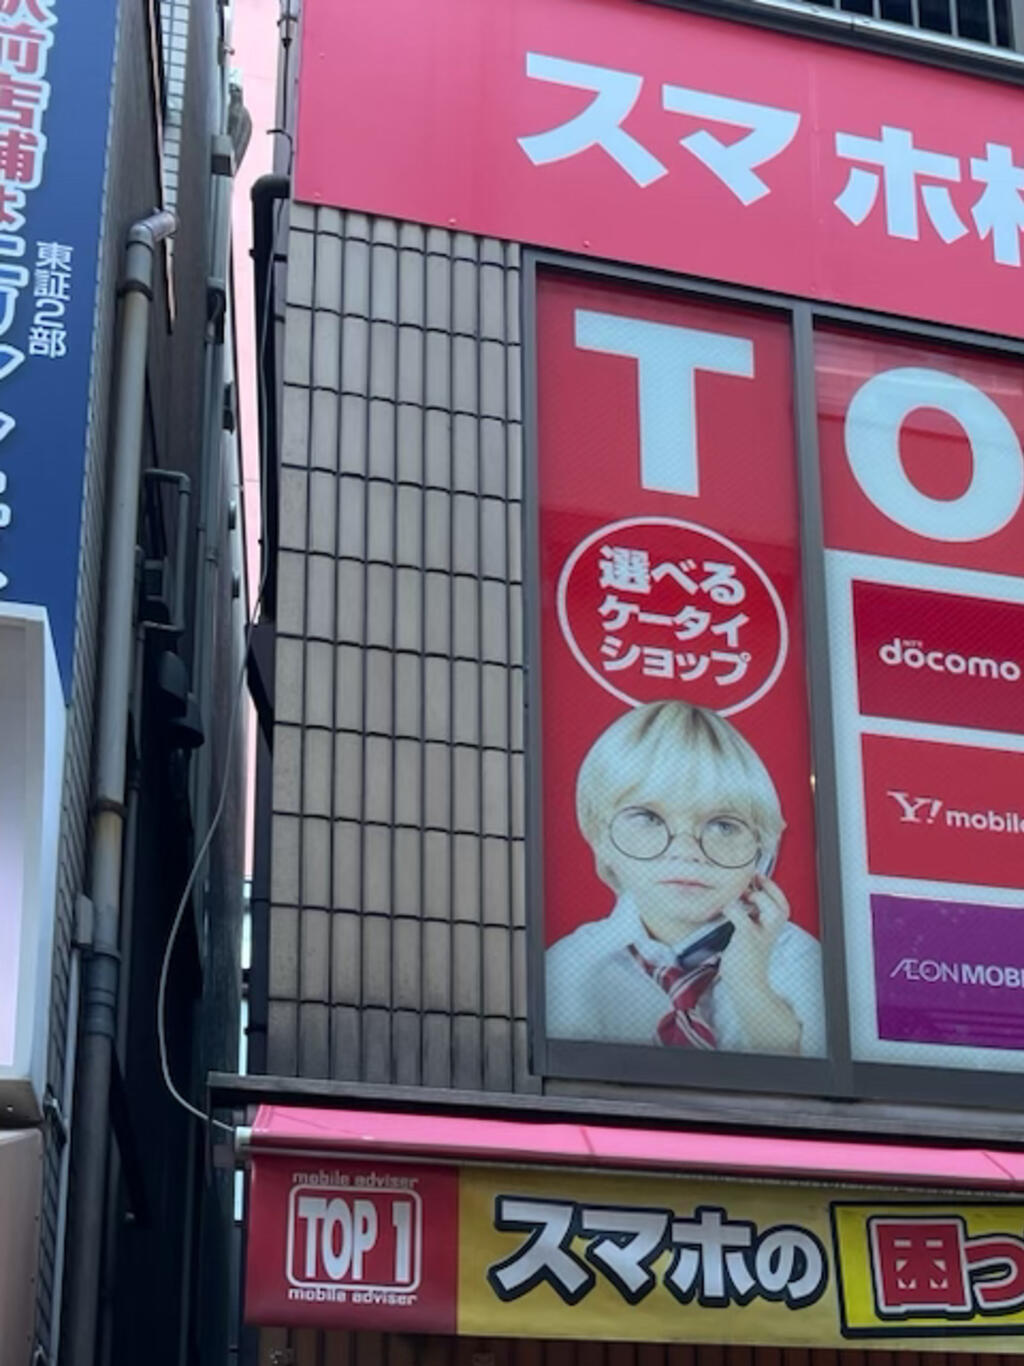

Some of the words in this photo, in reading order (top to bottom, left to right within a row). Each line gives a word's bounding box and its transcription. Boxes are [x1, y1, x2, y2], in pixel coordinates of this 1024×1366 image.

[29, 241, 73, 358] 東証2部
[598, 545, 746, 605] 選べる
[598, 602, 748, 648] ケータイ
[598, 638, 751, 686] ショップ
[878, 637, 1021, 683] docomo
[293, 1170, 349, 1185] mobile
[354, 1172, 418, 1188] adviser
[490, 1195, 826, 1306] スマホの
[289, 1288, 346, 1302] mobile
[352, 1290, 417, 1306] adviser
